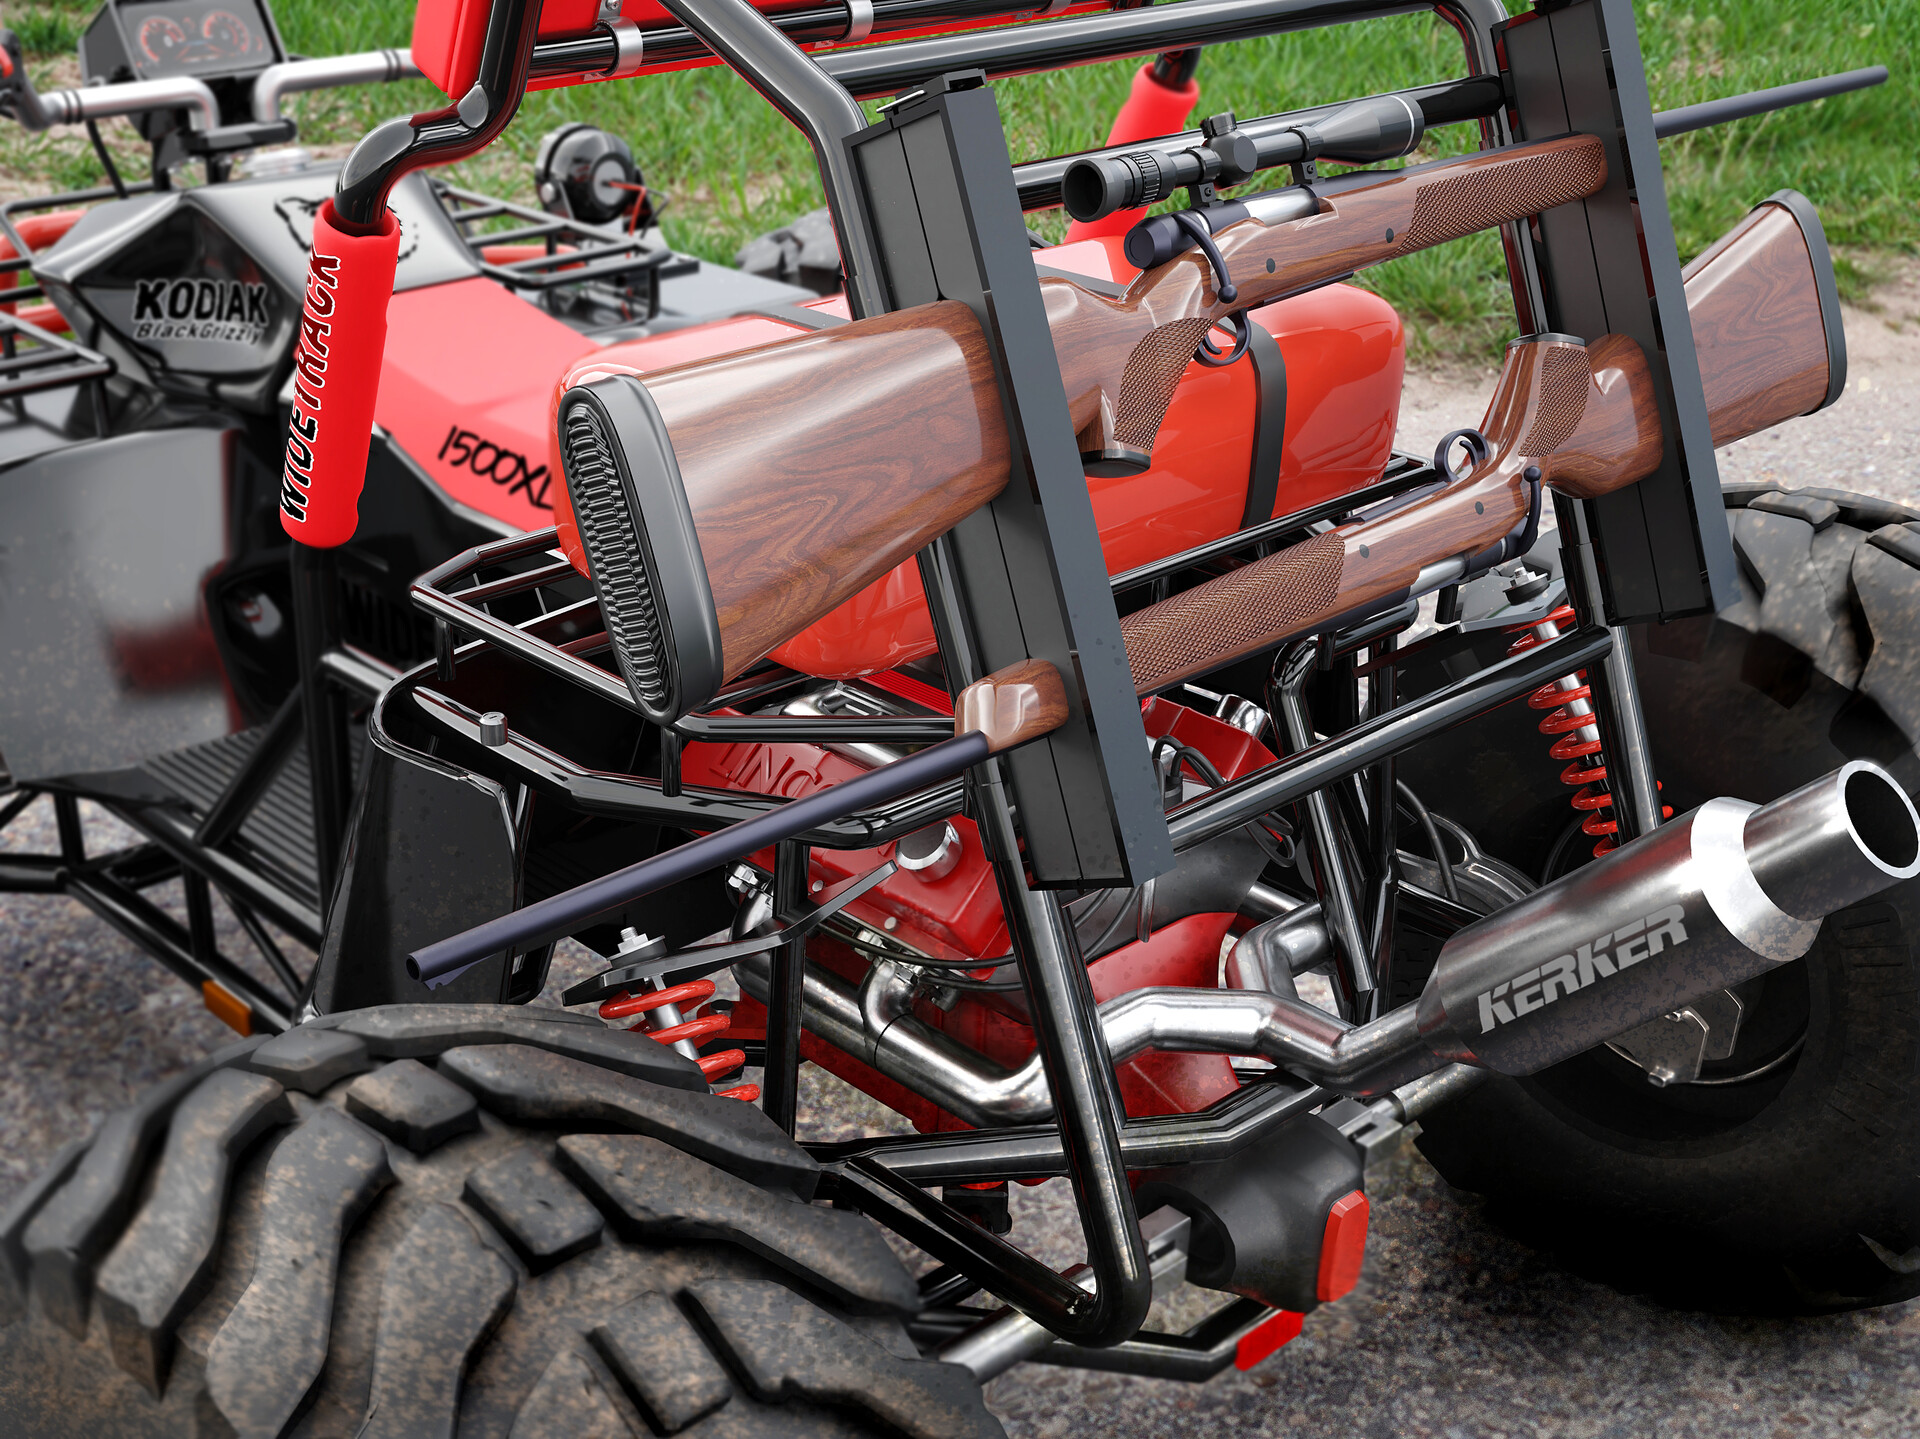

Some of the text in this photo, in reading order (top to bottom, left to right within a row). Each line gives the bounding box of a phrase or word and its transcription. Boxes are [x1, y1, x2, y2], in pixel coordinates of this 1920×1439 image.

[132, 278, 268, 326] KODIAK
[134, 321, 265, 345] BlackGrizzly
[279, 245, 341, 523] WIDETRACK
[437, 424, 554, 511] 1500XL
[1477, 904, 1689, 1035] KERKER
